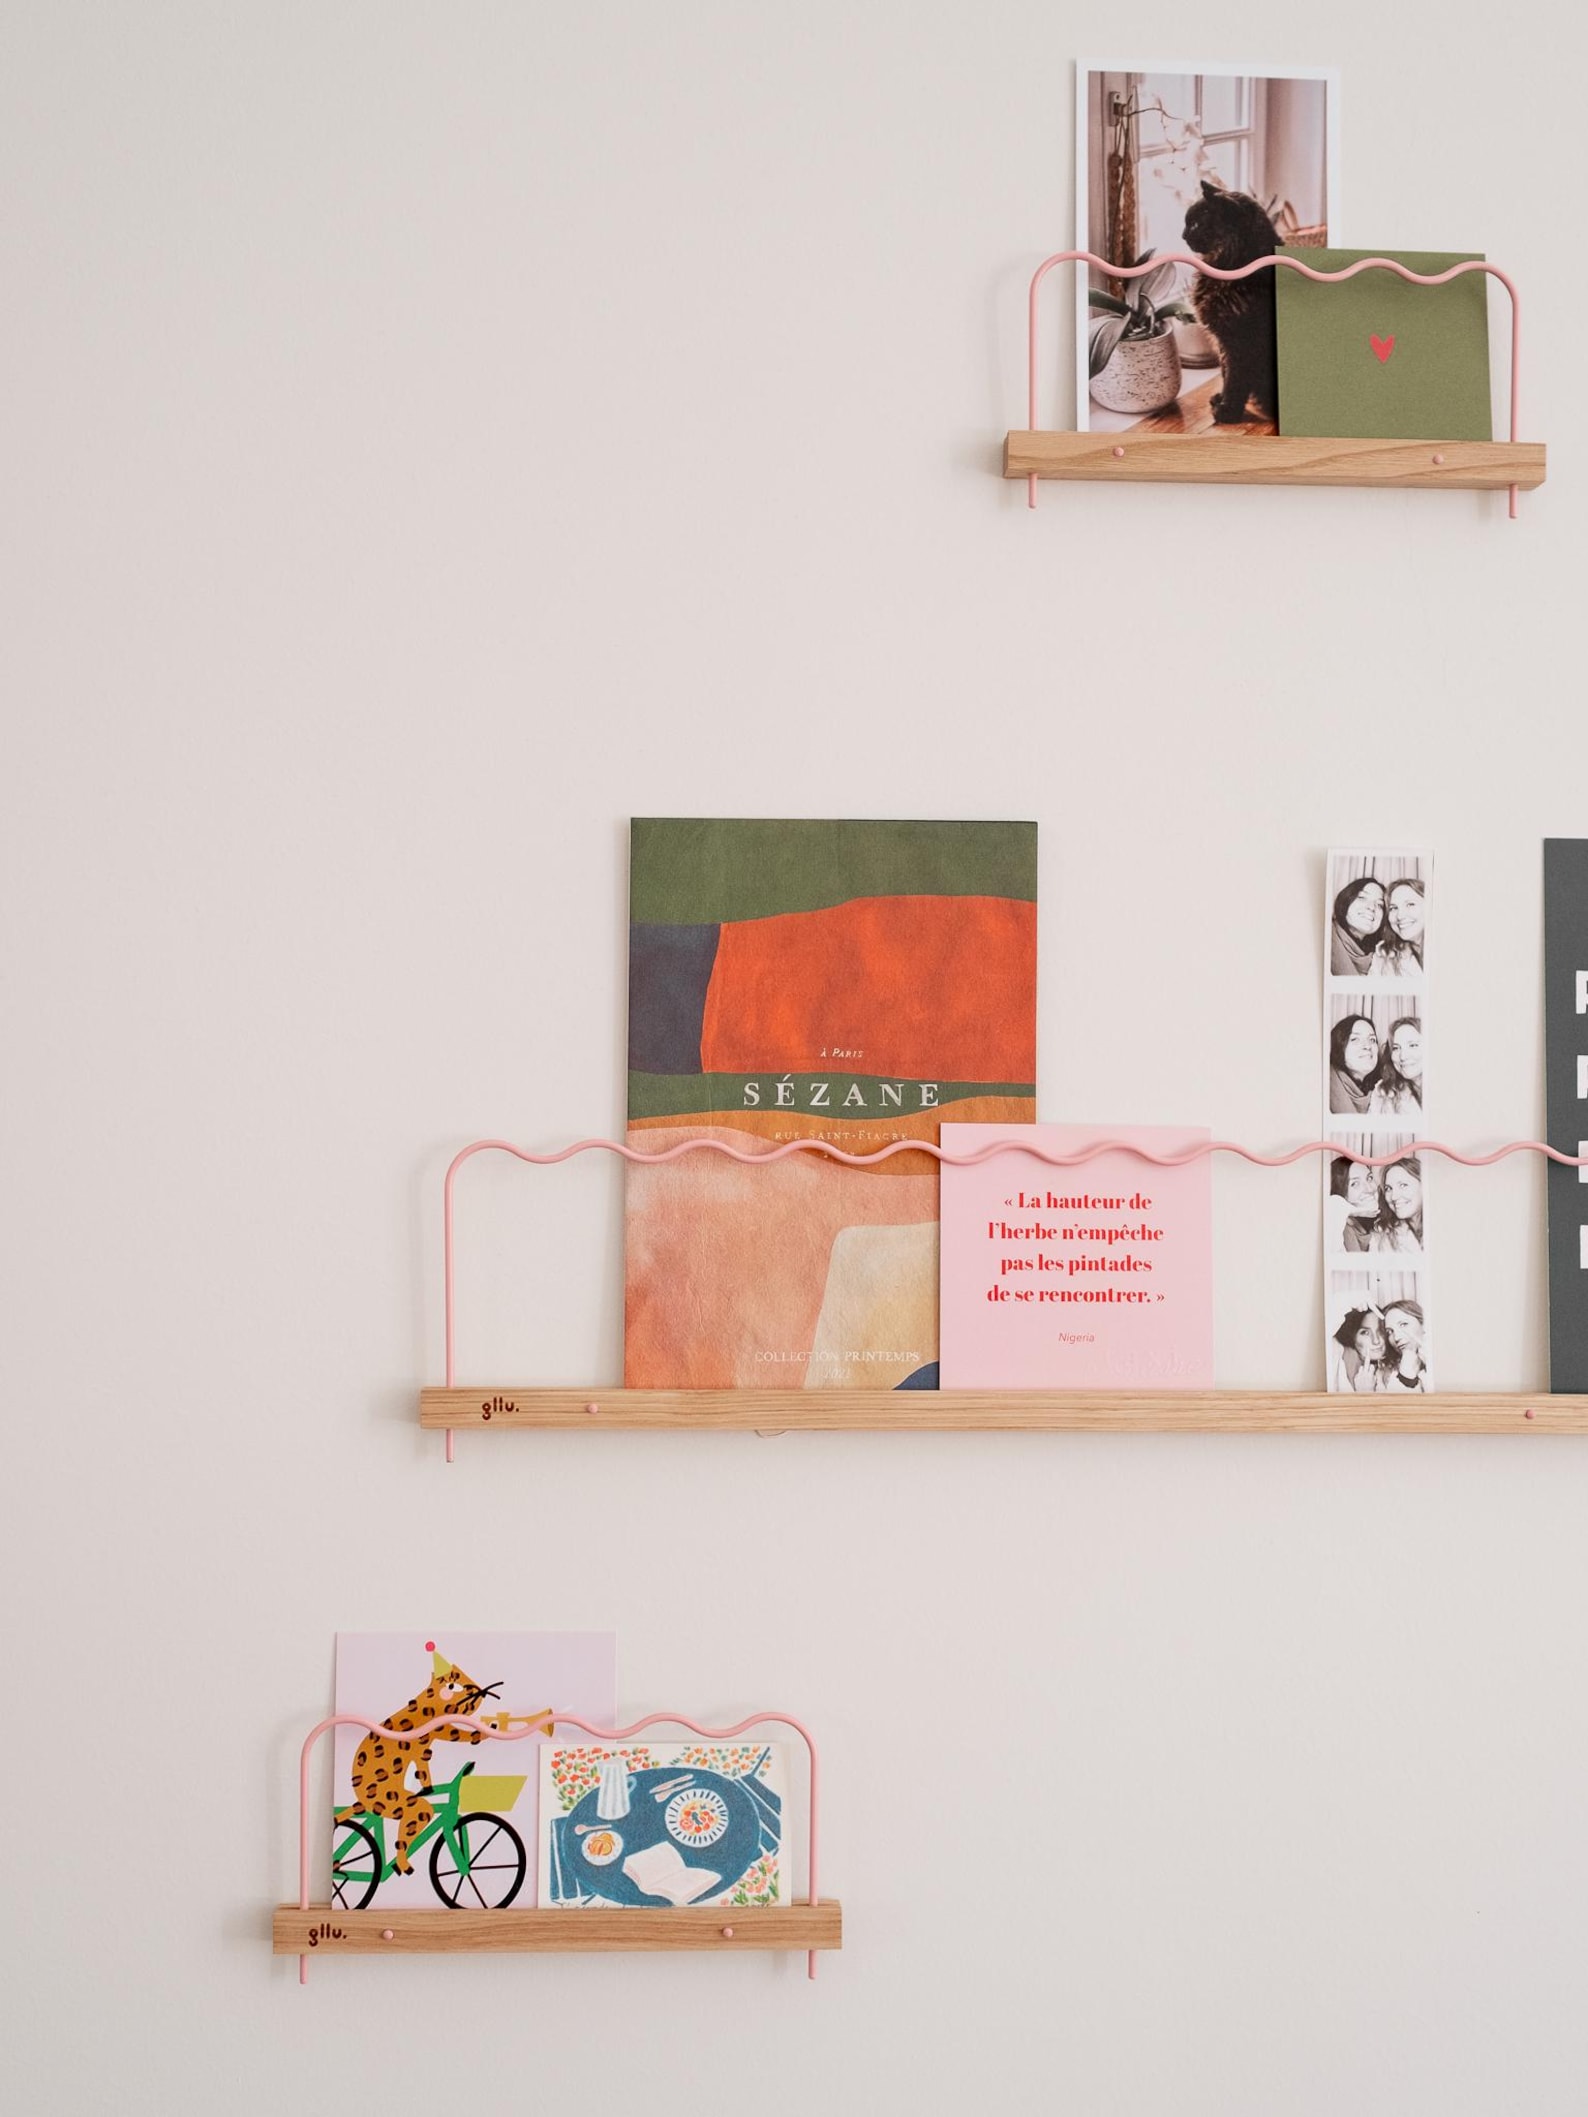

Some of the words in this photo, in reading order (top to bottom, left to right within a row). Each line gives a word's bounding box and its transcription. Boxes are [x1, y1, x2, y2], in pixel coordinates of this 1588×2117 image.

[743, 1074, 939, 1107] SÉZANE
[1018, 1192, 1041, 1209] La
[1046, 1192, 1126, 1210] hauteur
[1129, 1193, 1152, 1210] de
[1001, 1258, 1034, 1275] pas
[1038, 1254, 1065, 1271] les
[1068, 1255, 1153, 1276] pintades
[987, 1285, 1010, 1302] de
[1014, 1290, 1035, 1303] se
[1039, 1288, 1151, 1303] rencontrer.
[1058, 1332, 1095, 1344] Nigeria
[755, 1351, 839, 1362] COLLECTION
[845, 1351, 920, 1362] PRINTEMPS
